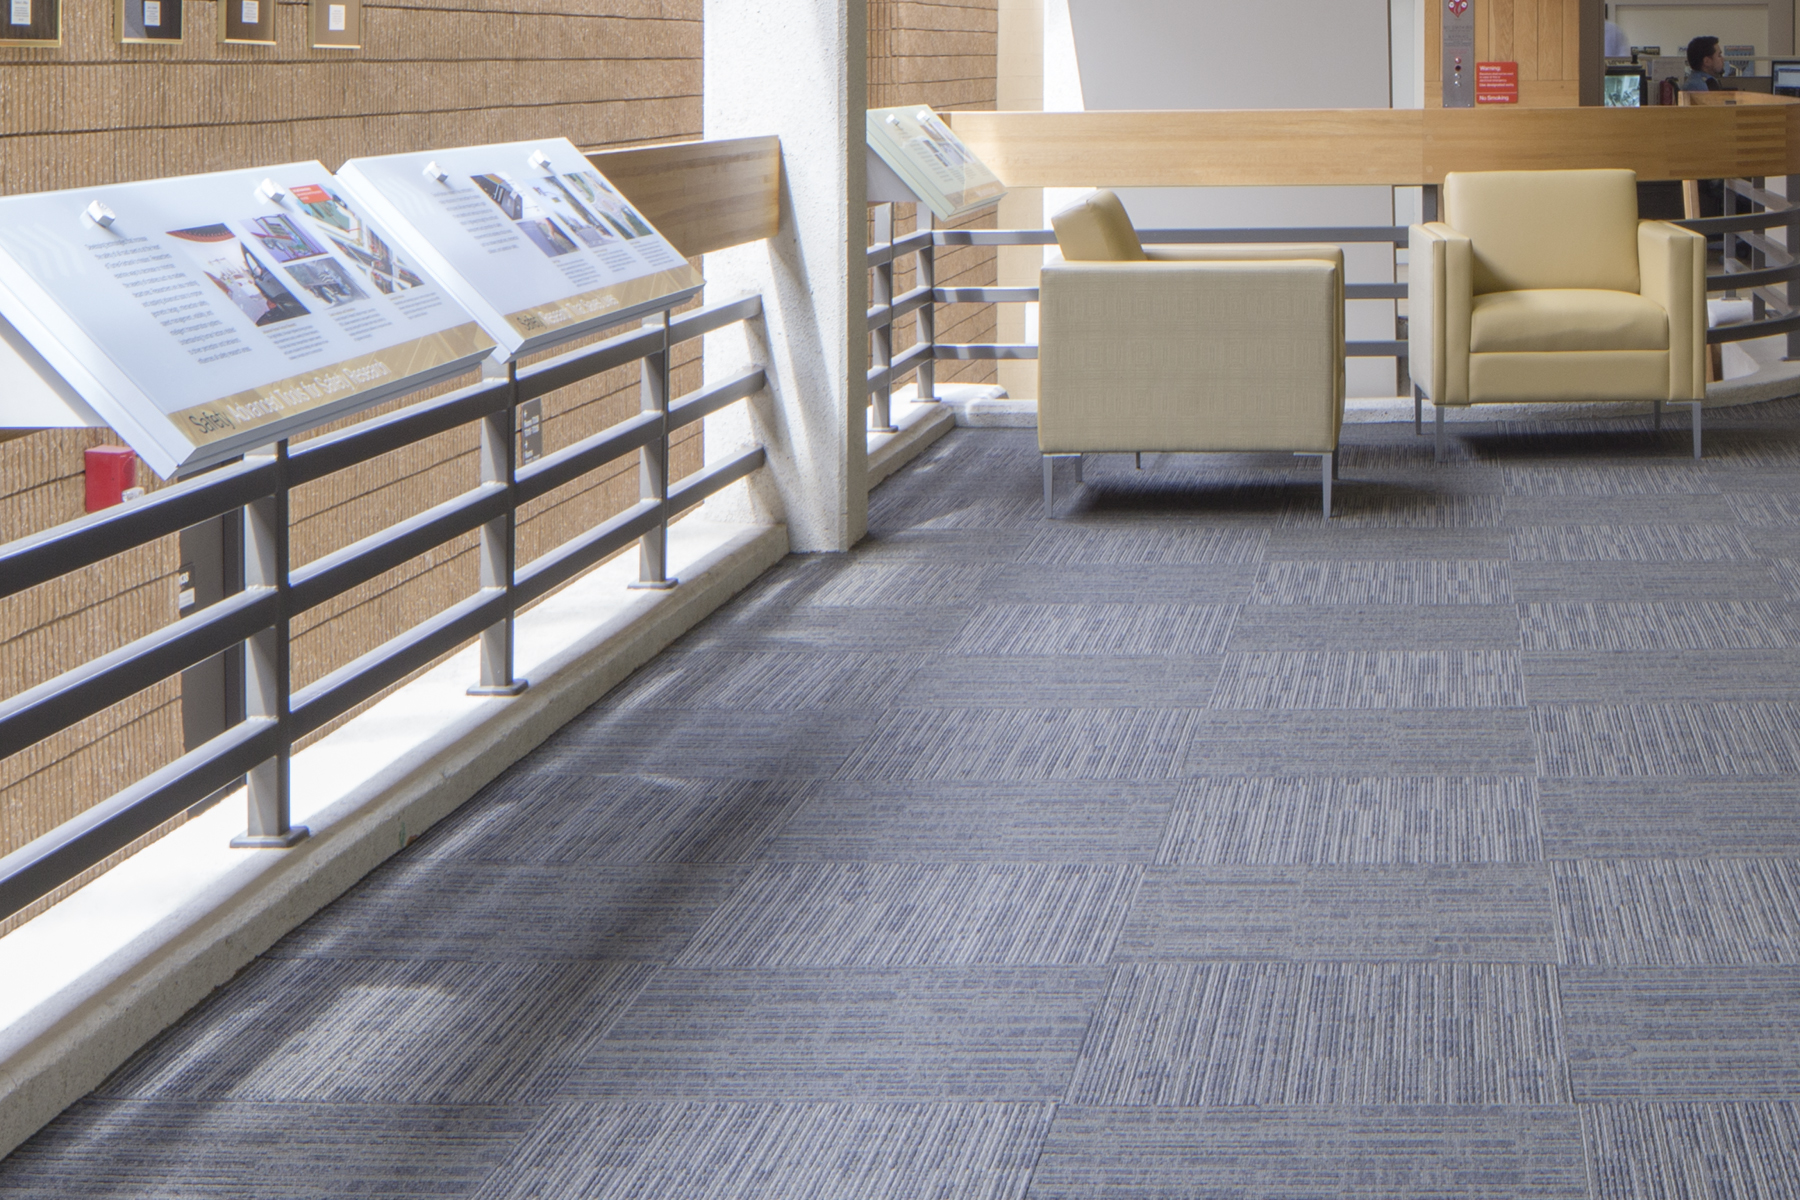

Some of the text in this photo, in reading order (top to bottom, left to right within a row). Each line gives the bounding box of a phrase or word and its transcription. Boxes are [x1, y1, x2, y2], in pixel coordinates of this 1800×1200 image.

[188, 408, 236, 434] Safety
[226, 395, 285, 425] Advanced
[273, 384, 311, 407] Tools
[342, 359, 393, 386] Research
